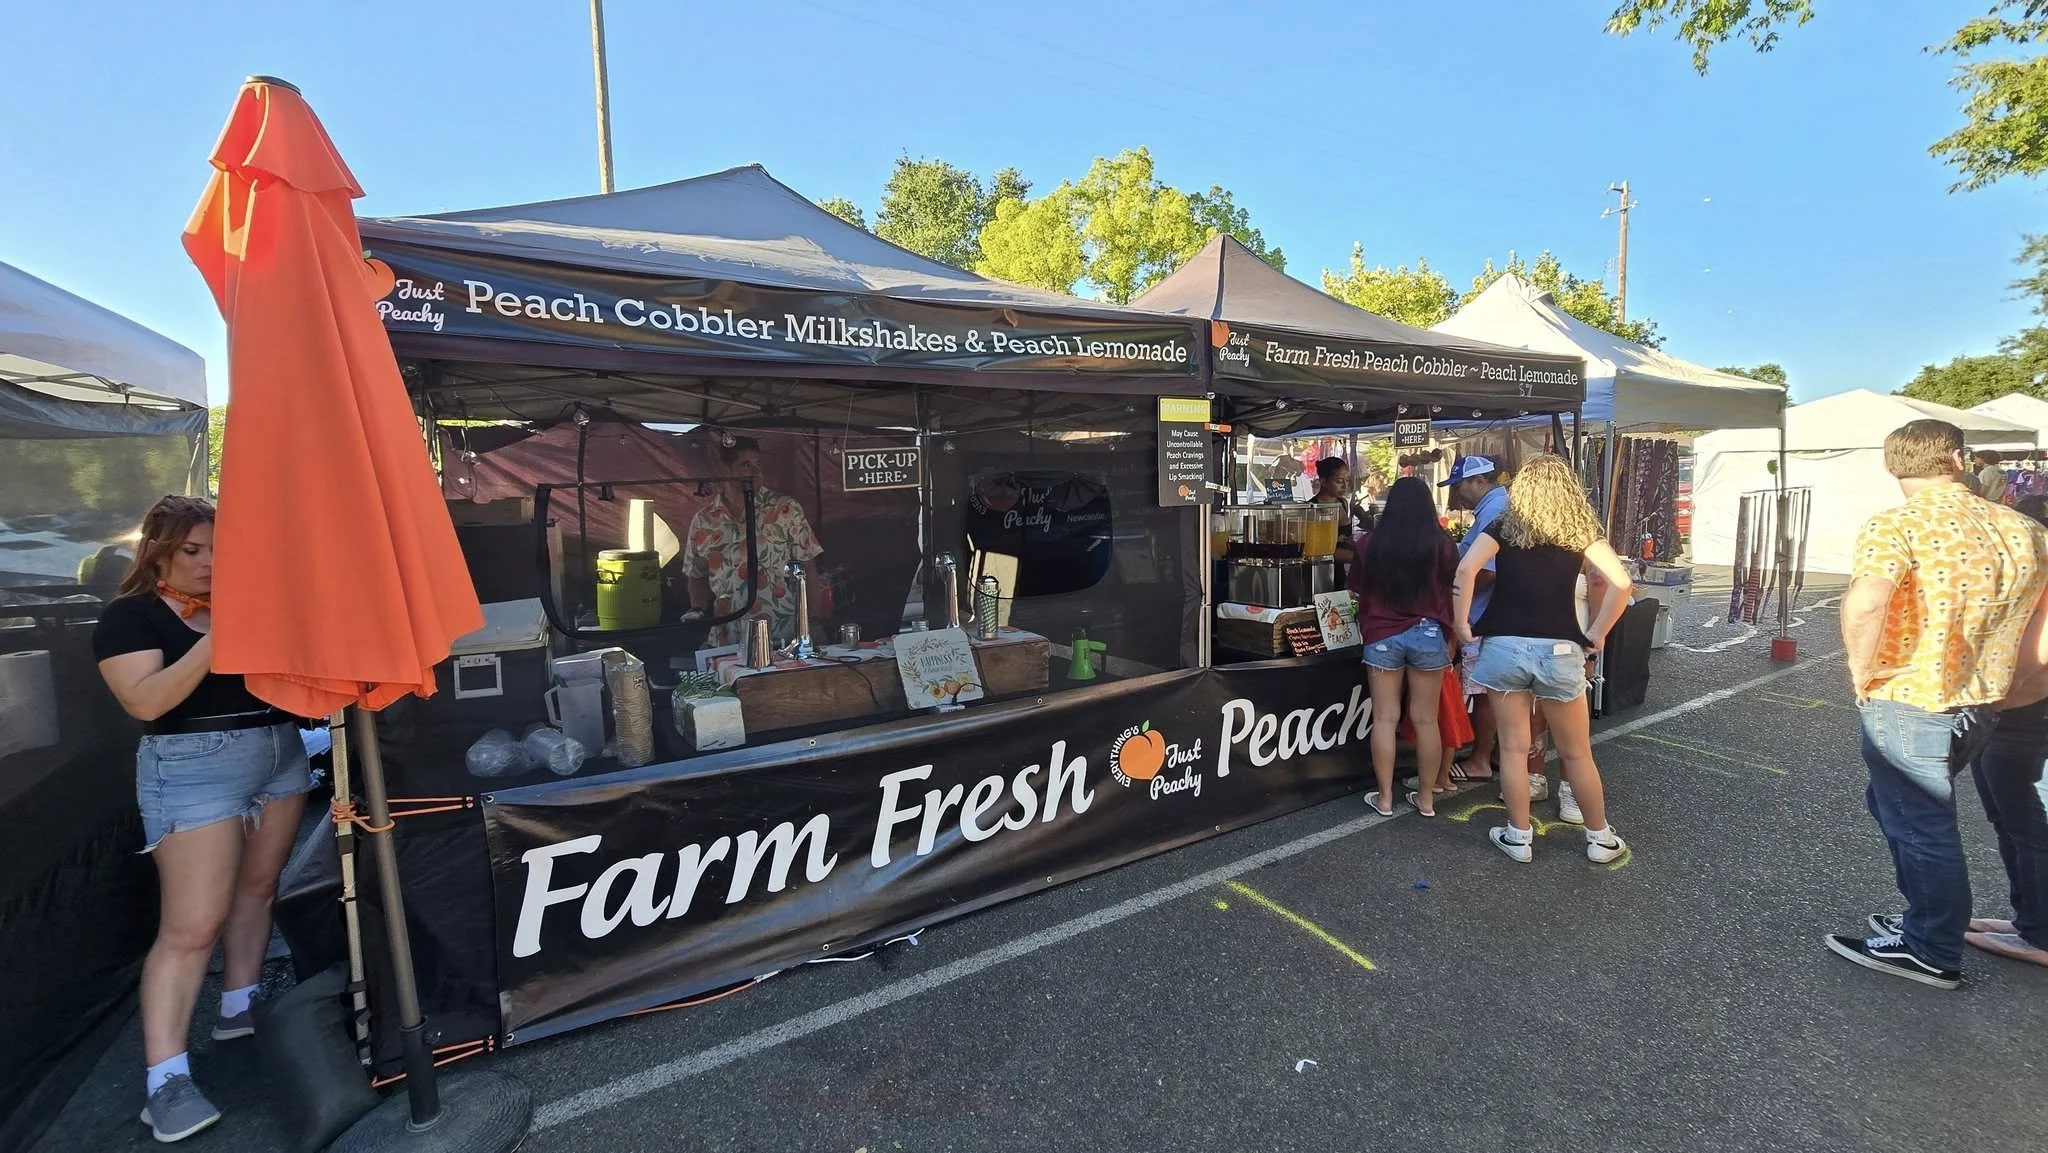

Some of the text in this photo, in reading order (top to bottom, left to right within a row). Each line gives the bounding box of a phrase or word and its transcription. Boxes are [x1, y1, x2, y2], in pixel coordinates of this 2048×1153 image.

[395, 279, 445, 300] Just
[375, 300, 445, 331] Peachy
[463, 279, 1188, 364] Peach Cobbler Milkshakes & Peach Lemonade
[1228, 332, 1250, 346] Just
[1219, 346, 1250, 367] Peachy
[1265, 341, 1310, 366] Farm
[1313, 346, 1360, 370] Fresh
[1363, 351, 1409, 374] Peach
[1412, 355, 1467, 379] Cobbler
[1480, 361, 1518, 382] Peach
[1519, 365, 1579, 386] Lemonade
[1171, 430, 1199, 439] May Cause
[1398, 423, 1427, 435] ORDER
[847, 452, 917, 470] PICK-UP
[1166, 451, 1204, 460] Peach Cravings
[1169, 462, 1204, 470] and Excessive
[1168, 472, 1205, 482] Lip Smacking!
[1217, 684, 1373, 778] Peach
[1109, 725, 1141, 788] EVERYTHING'S
[1165, 738, 1202, 769] Just
[1149, 765, 1202, 800] Peachy
[512, 740, 1094, 958] Farm Fresh
